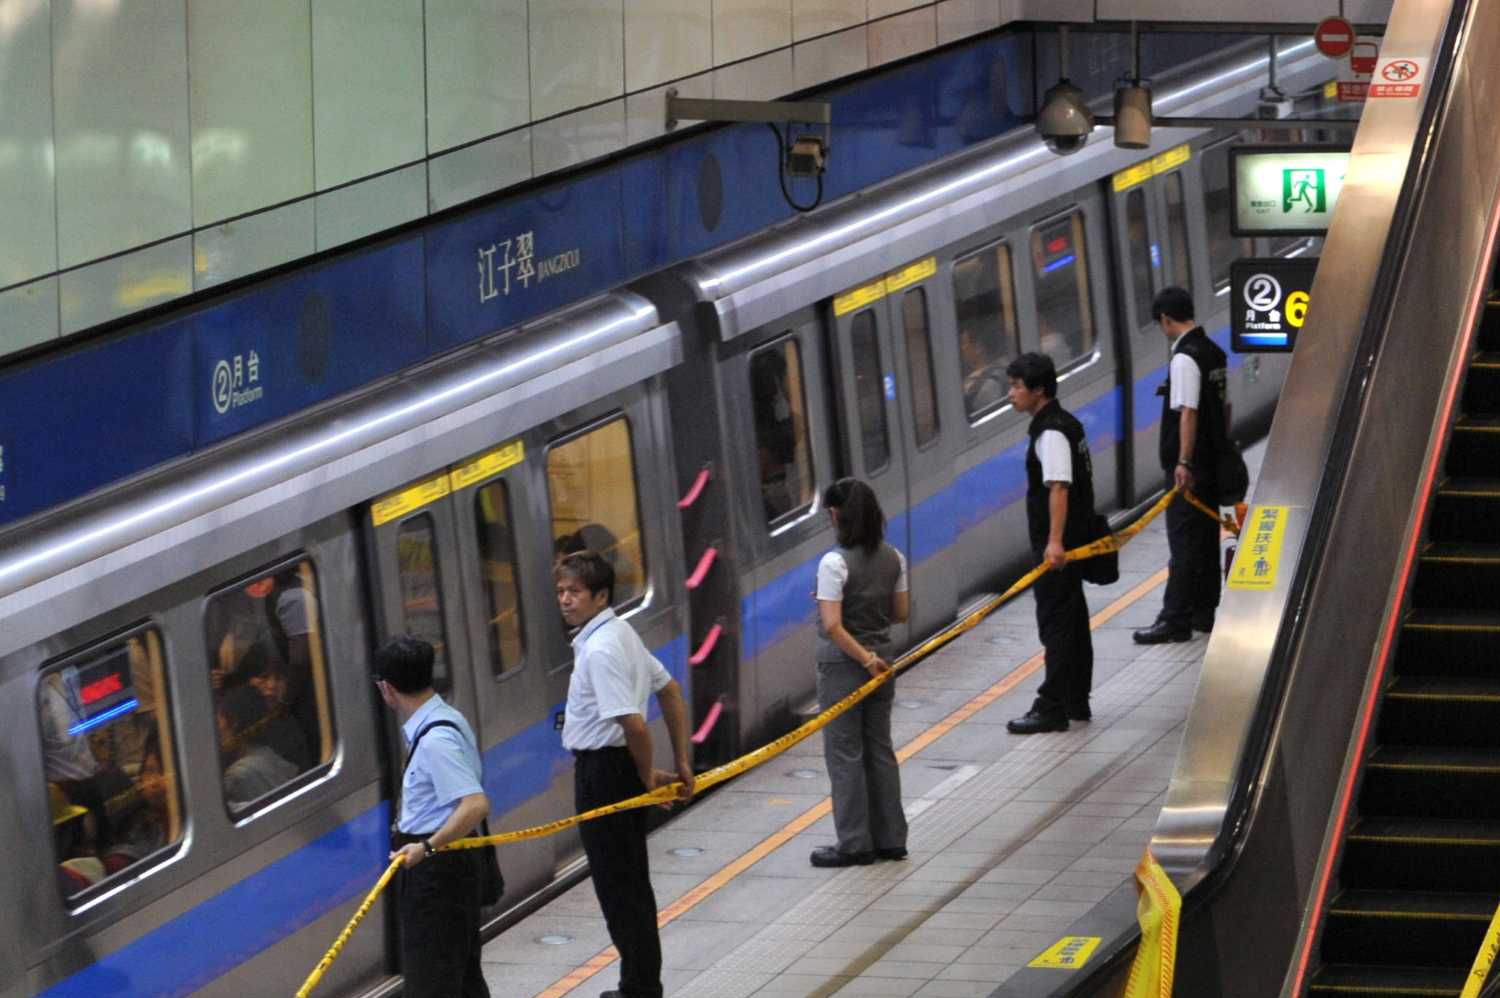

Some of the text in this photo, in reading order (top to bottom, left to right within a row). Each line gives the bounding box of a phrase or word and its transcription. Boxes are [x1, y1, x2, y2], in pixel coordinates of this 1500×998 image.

[478, 231, 535, 304] 江子翠
[1246, 309, 1281, 323] 月台
[1285, 291, 1311, 328] 6
[1245, 321, 1281, 330] Platform
[232, 350, 259, 388] 月台
[232, 387, 262, 408] Platform
